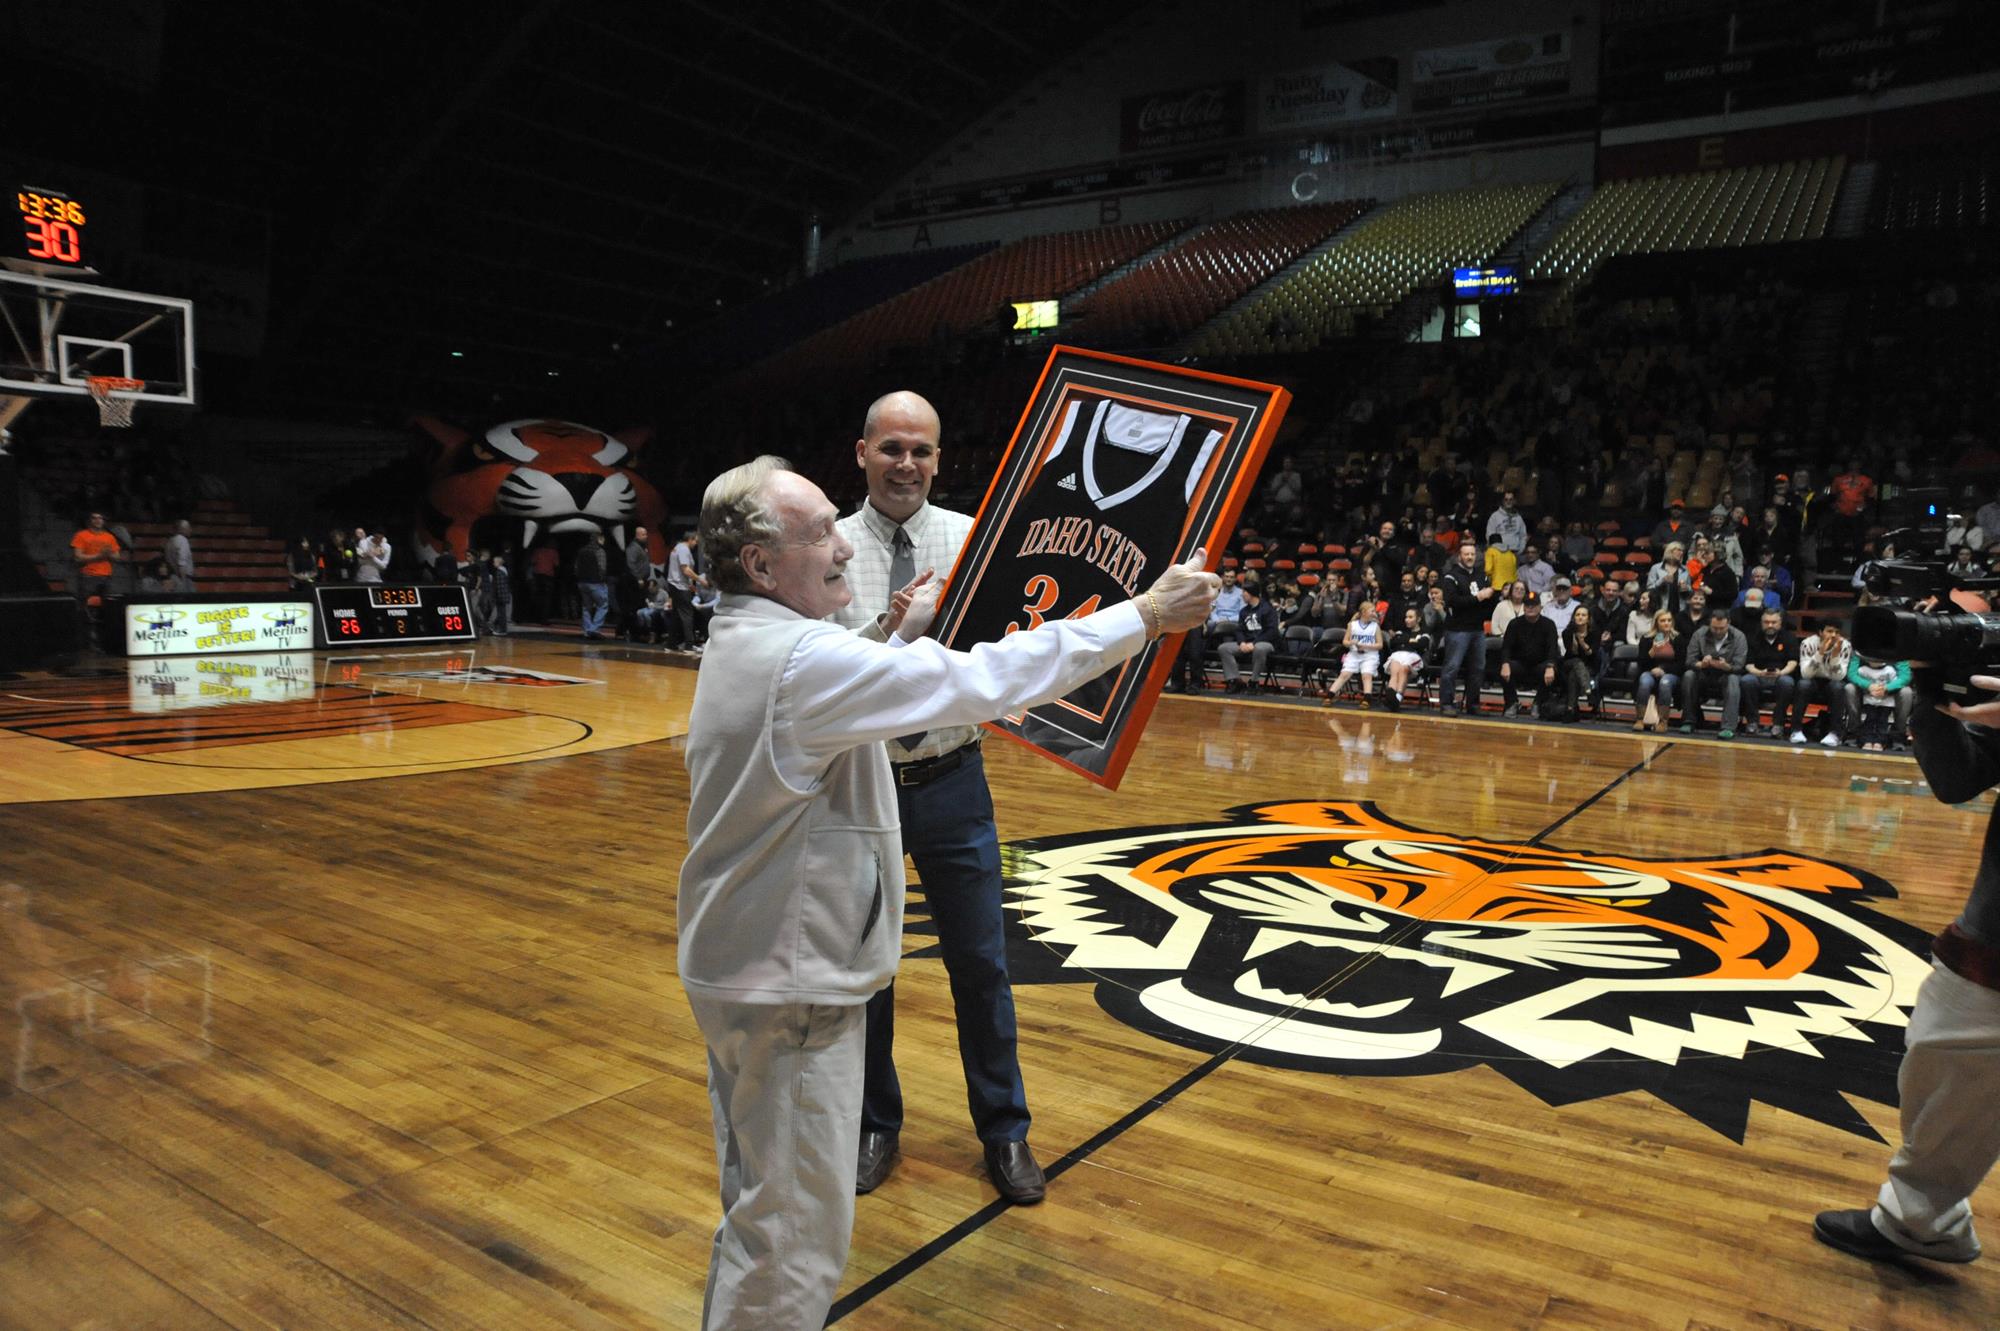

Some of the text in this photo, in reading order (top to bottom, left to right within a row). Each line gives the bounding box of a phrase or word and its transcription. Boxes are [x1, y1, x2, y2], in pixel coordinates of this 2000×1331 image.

[1274, 74, 1323, 92] Ruby
[1265, 87, 1350, 110] Tuesday
[1291, 172, 1318, 201] C
[1101, 199, 1122, 224] B
[24, 216, 80, 262] 30
[913, 224, 932, 247] A
[1057, 480, 1077, 491] adidas
[1016, 516, 1147, 598] IDAHO STATE
[196, 606, 249, 624] BIGGER
[333, 609, 357, 618] HOME
[437, 606, 460, 616] GUEST
[133, 627, 189, 642] Merlins
[216, 621, 232, 633] IS
[261, 624, 309, 639] Merlins
[341, 619, 361, 635] 26
[152, 640, 169, 652] TV
[195, 629, 256, 649] BETTER!
[278, 636, 293, 649] TV
